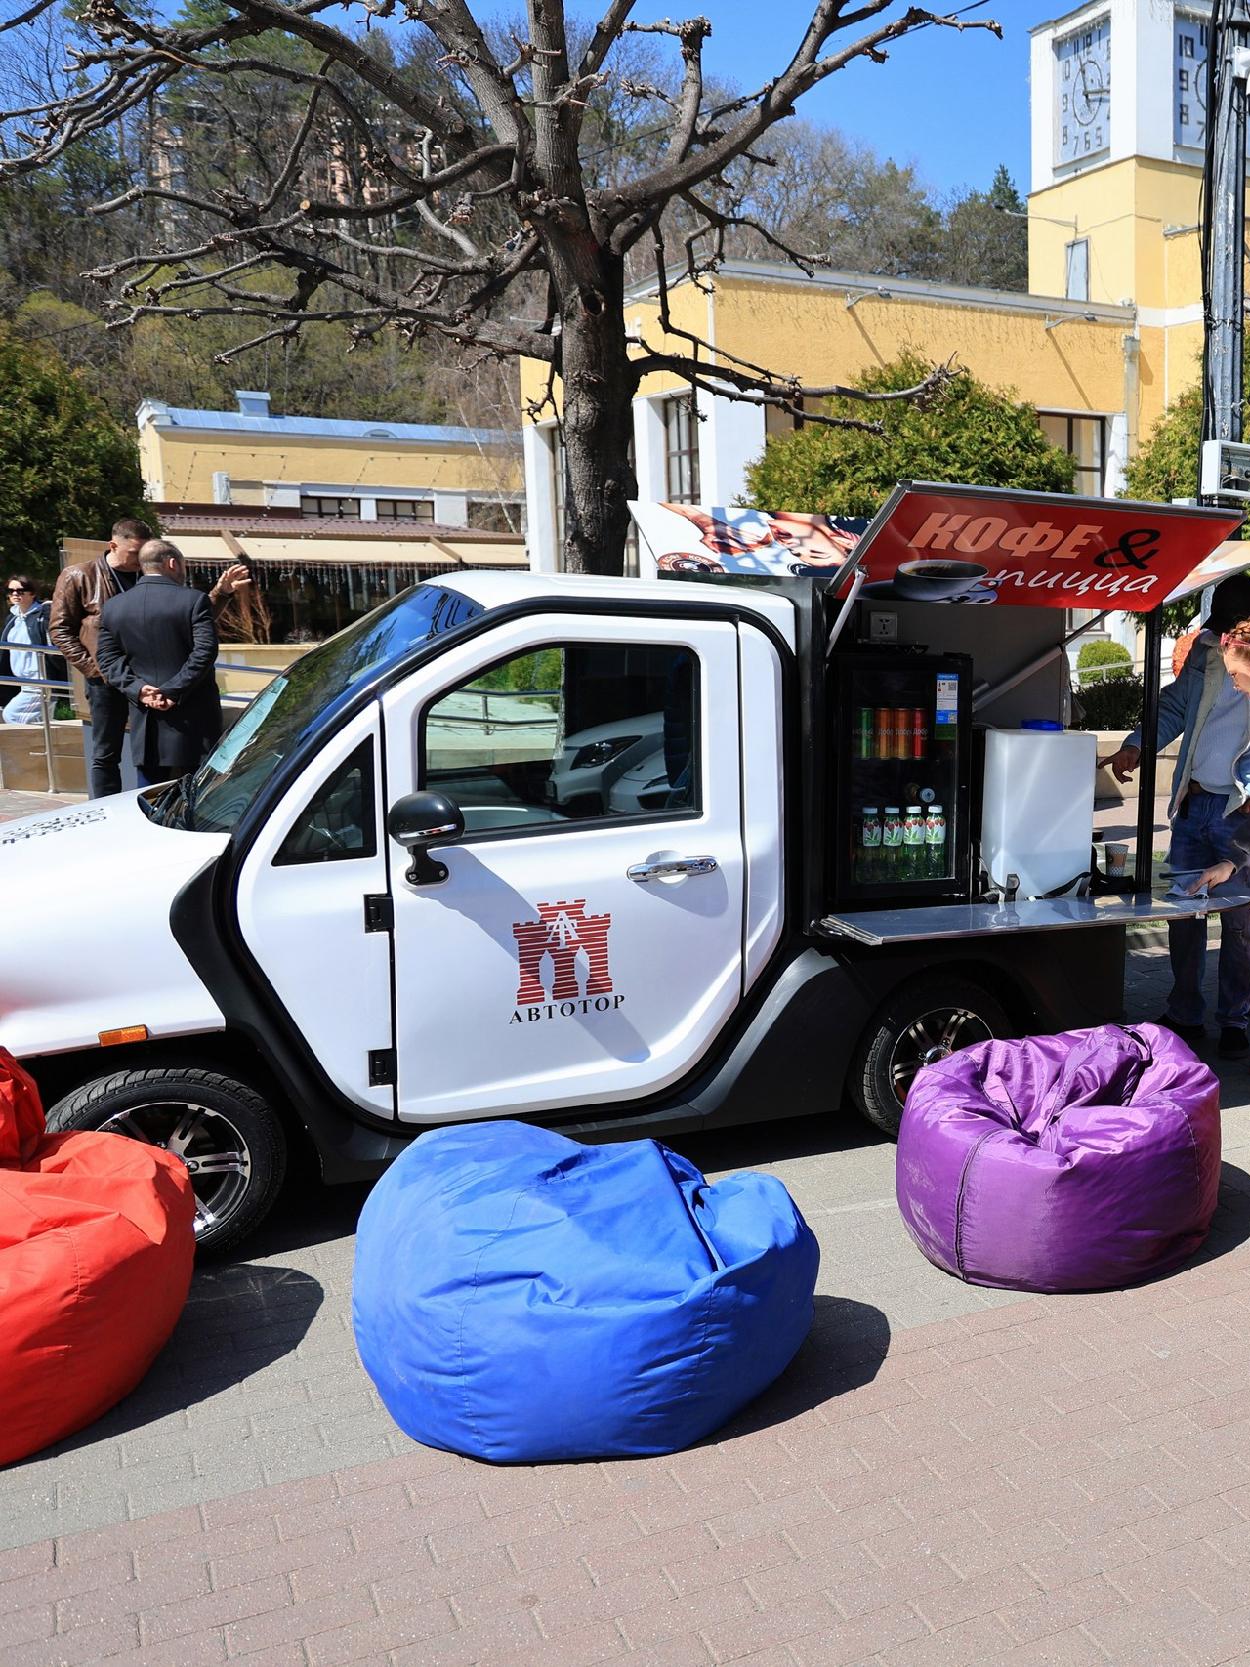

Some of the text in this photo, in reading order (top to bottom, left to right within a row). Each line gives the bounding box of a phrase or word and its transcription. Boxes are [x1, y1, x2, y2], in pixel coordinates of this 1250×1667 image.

[907, 512, 1161, 570] КОФЕ &
[988, 569, 1159, 597] пицца
[509, 995, 625, 1024] АВТОТОР
